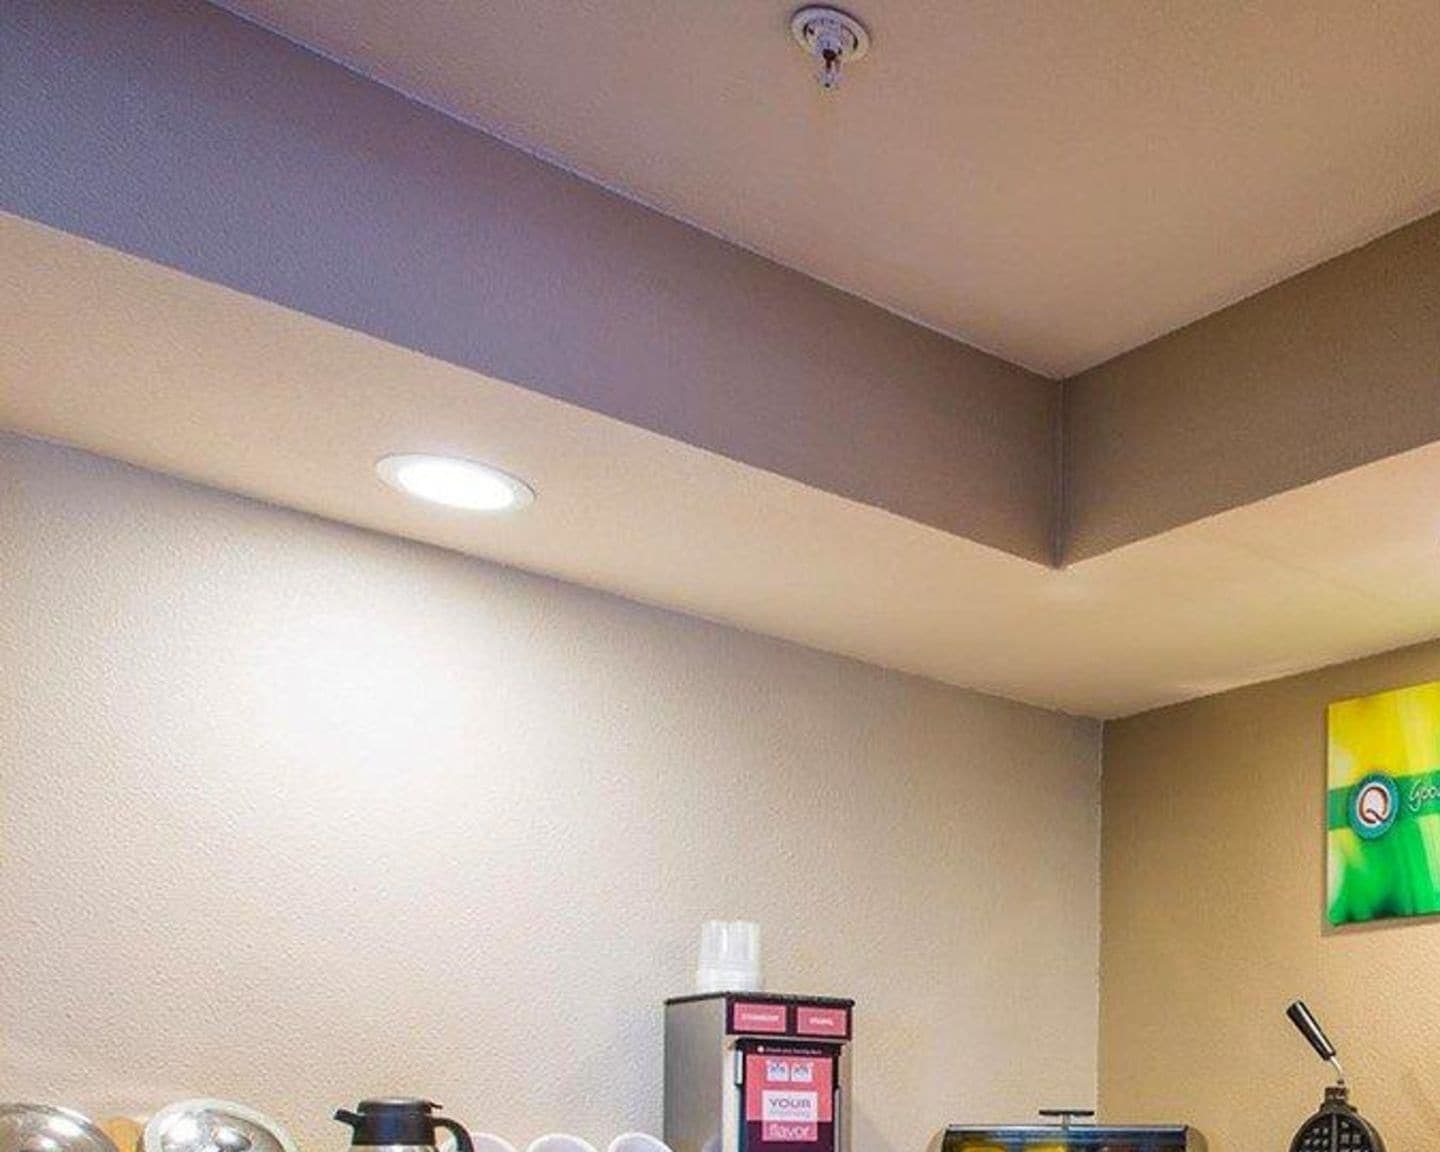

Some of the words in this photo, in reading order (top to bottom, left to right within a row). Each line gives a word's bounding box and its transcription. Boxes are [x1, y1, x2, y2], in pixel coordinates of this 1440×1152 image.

[1357, 784, 1390, 826] Q
[768, 1098, 811, 1108] YOUR
[769, 1122, 812, 1138] flavor
